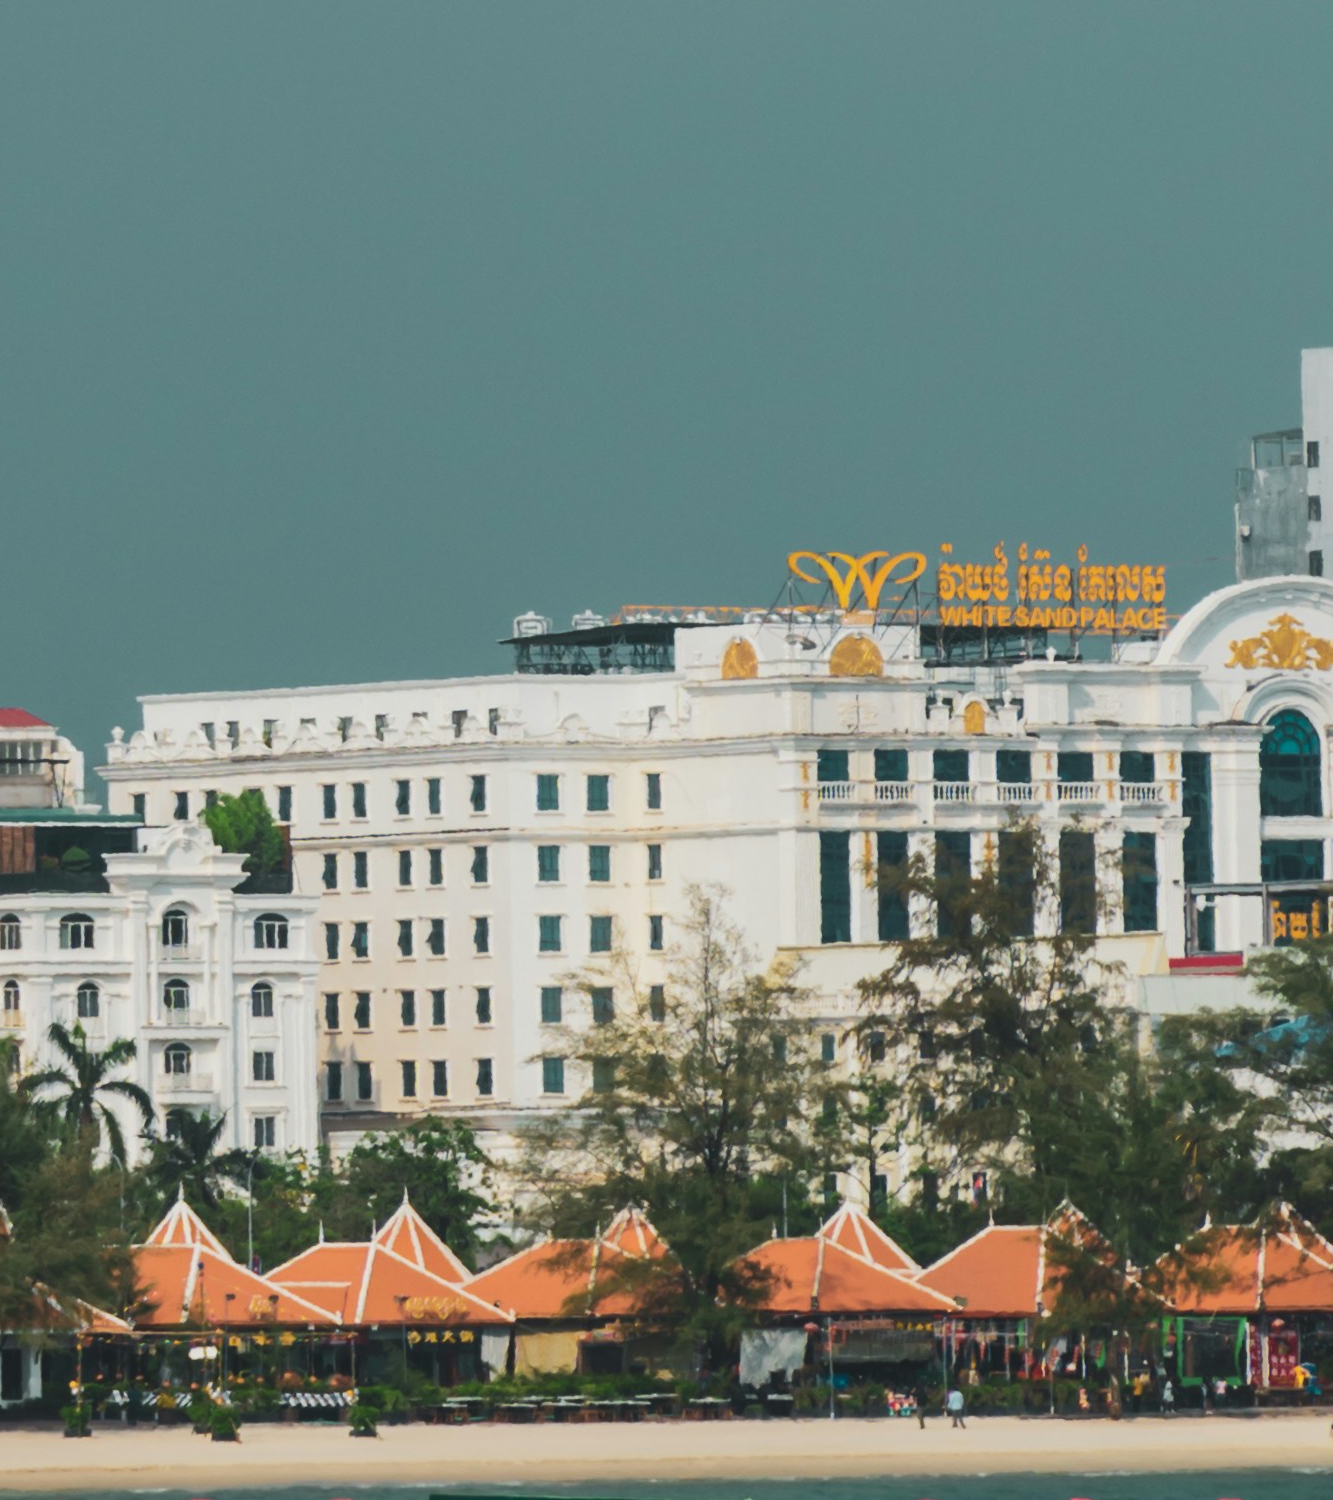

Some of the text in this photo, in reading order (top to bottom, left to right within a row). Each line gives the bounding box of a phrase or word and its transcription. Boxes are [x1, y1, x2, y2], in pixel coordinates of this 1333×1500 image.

[940, 606, 1167, 629] WHITE SAND PALACE
